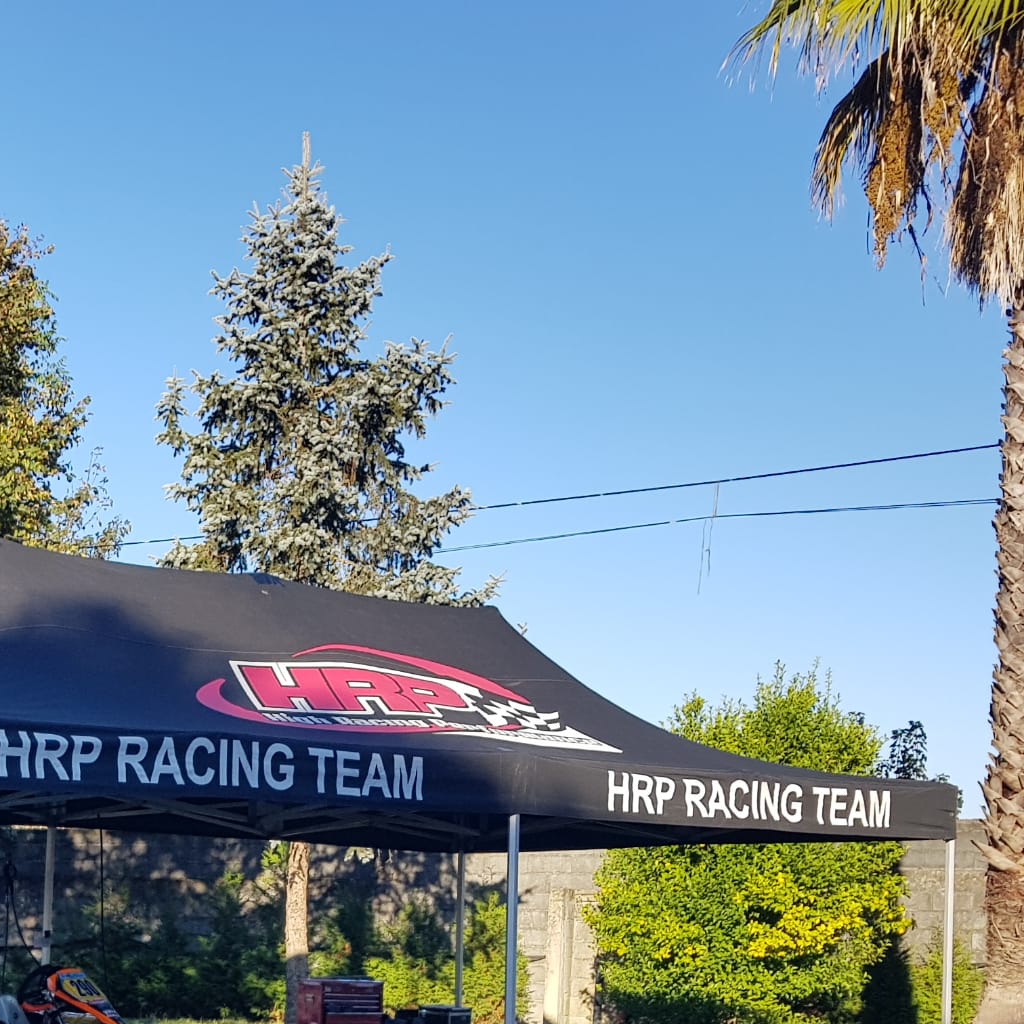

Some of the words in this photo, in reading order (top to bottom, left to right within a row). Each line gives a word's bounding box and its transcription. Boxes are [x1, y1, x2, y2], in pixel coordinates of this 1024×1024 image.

[231, 661, 474, 717] HRP
[262, 712, 333, 725] High
[332, 716, 430, 728] Racing
[117, 736, 296, 788] RACING
[308, 747, 424, 801] TEAM
[607, 770, 675, 815] HRP
[683, 778, 803, 823] RACING
[813, 786, 891, 829] TEAM
[69, 979, 101, 997] 290
